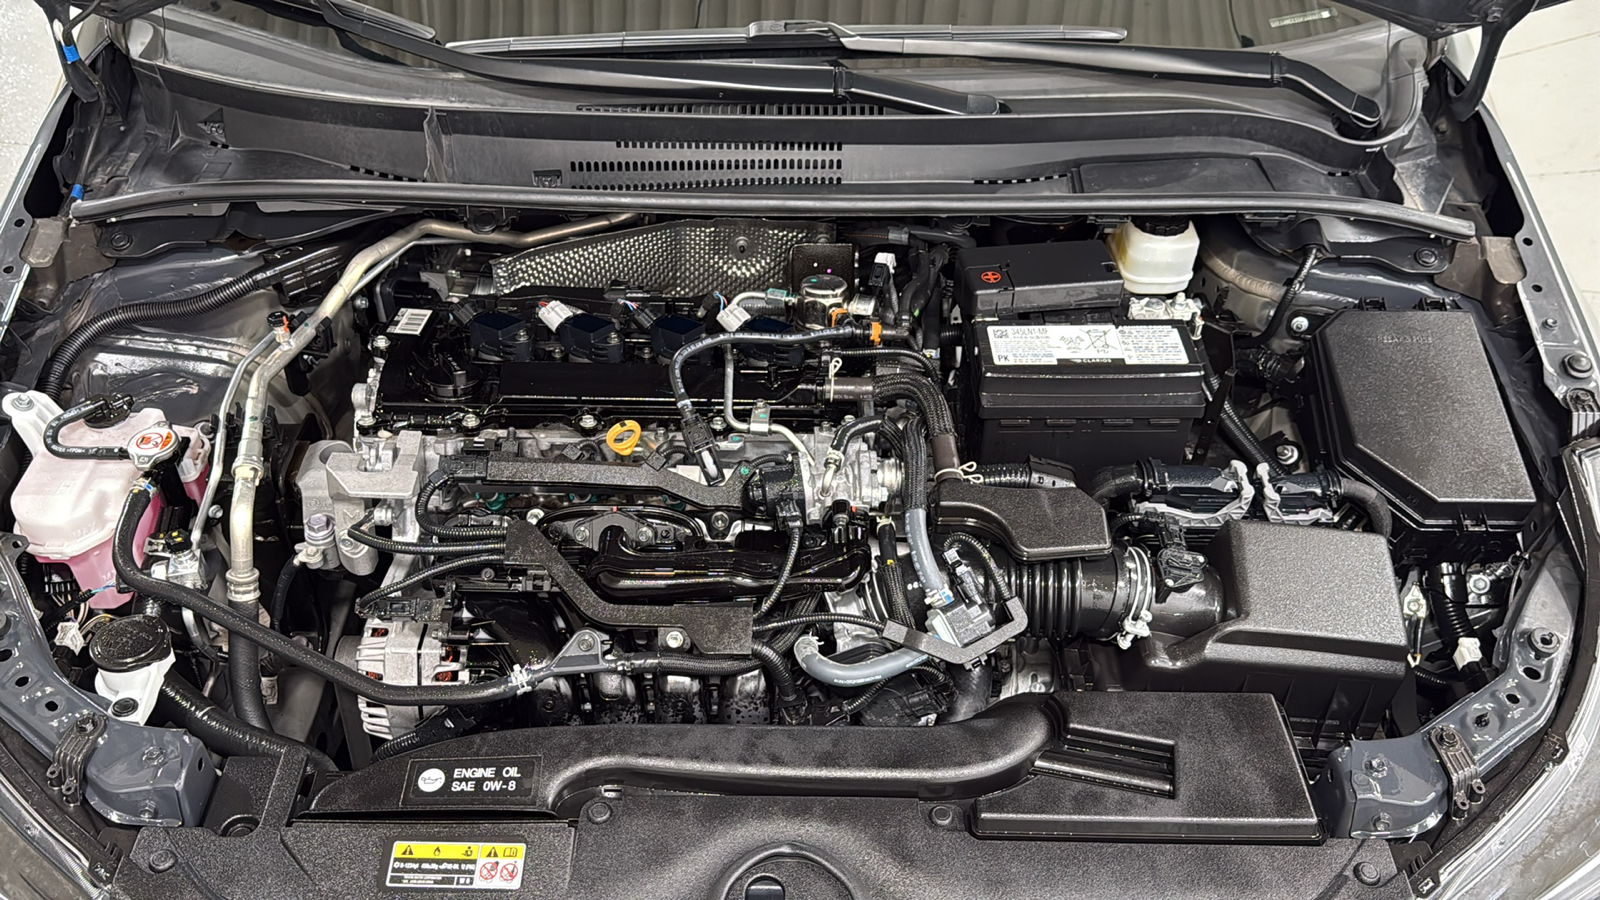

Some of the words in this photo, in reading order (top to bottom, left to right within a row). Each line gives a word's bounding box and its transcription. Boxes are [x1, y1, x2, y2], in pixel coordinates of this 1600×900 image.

[997, 354, 1010, 362] PK
[453, 767, 496, 778] ENGINE
[502, 766, 521, 777] OIL
[451, 781, 476, 792] SAE
[483, 780, 516, 791] 0W-8
